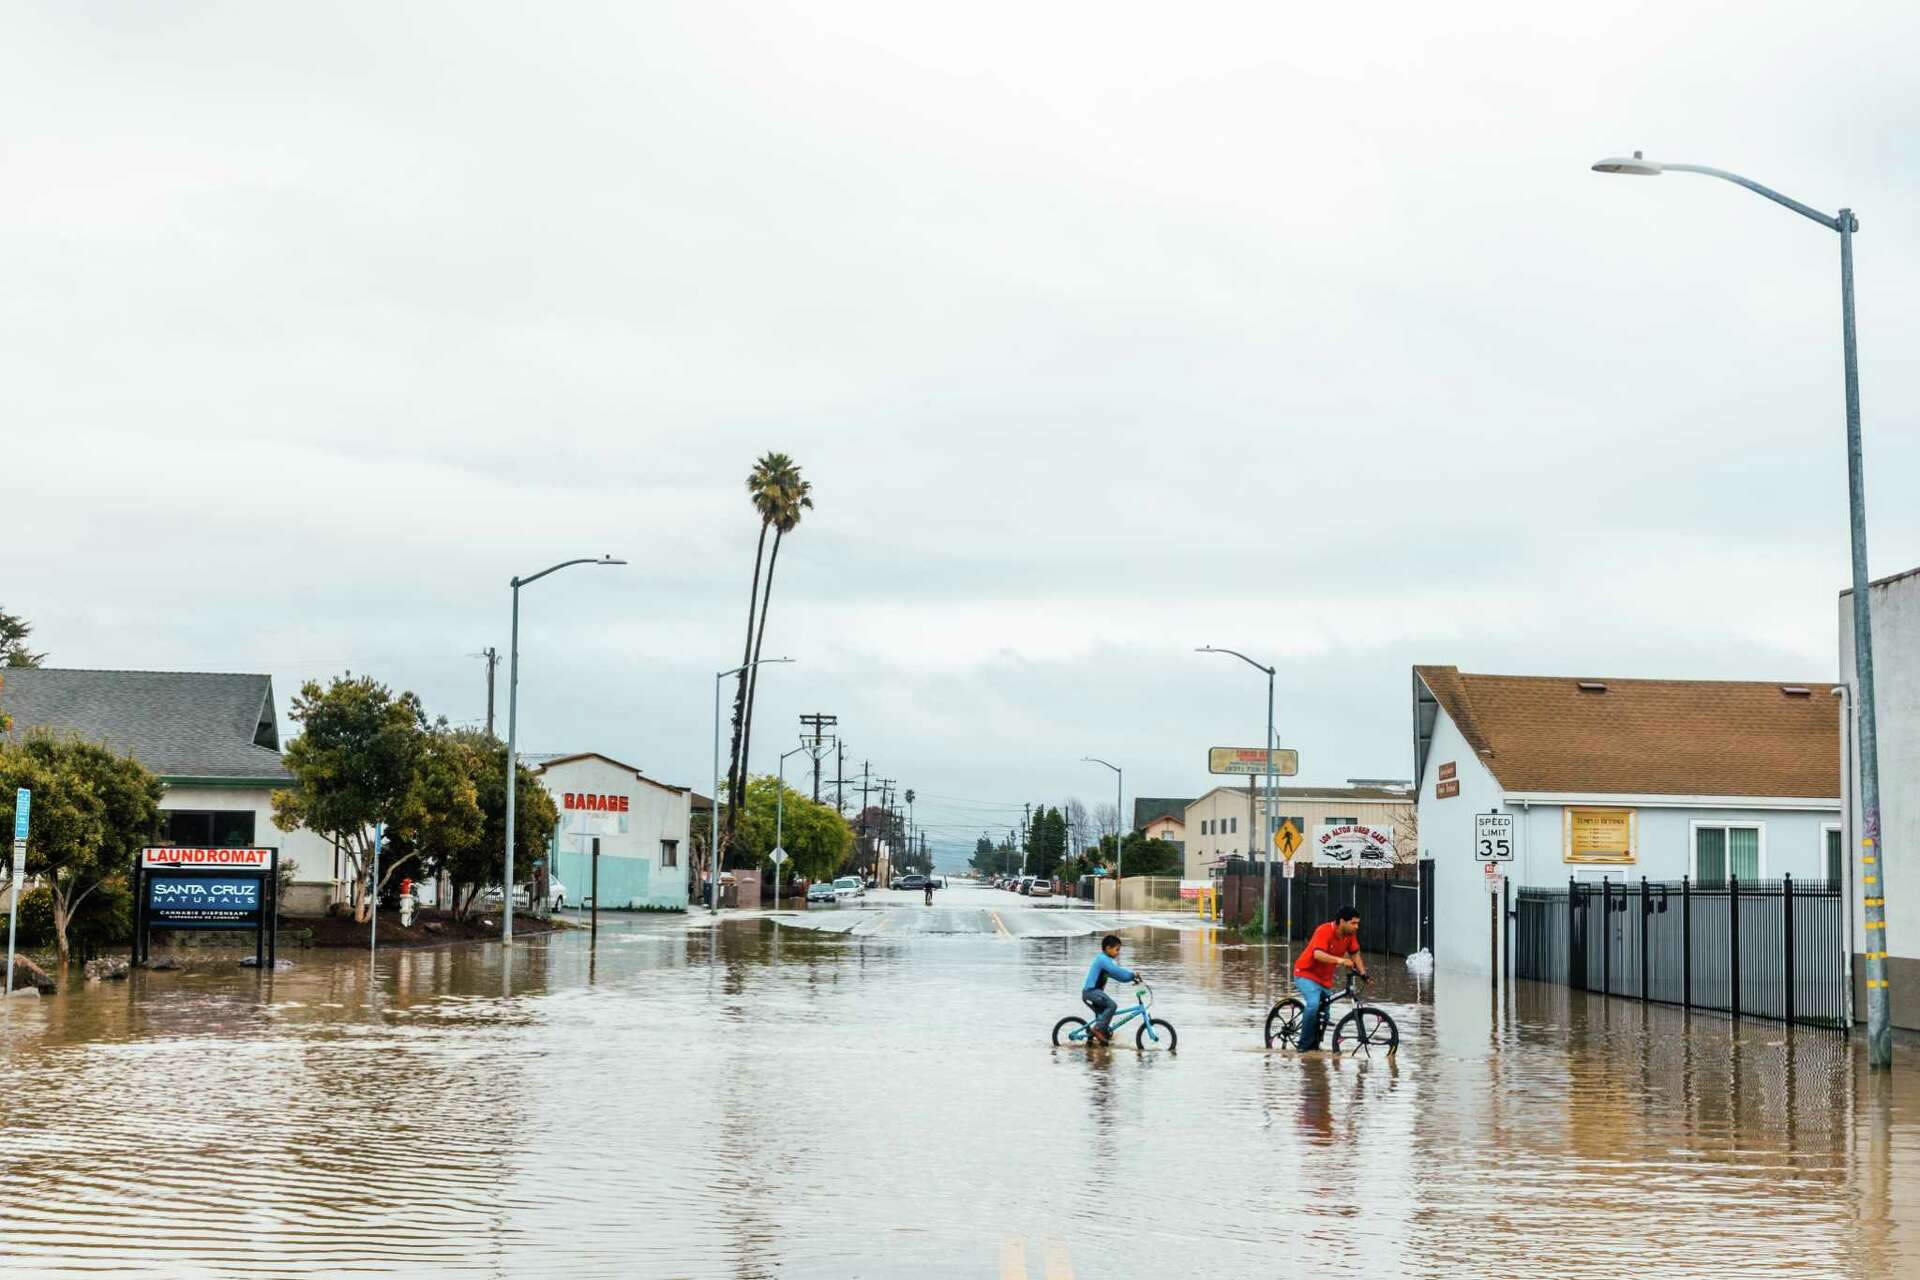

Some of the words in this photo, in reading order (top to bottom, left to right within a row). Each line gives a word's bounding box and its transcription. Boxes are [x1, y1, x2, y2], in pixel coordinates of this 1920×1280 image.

[564, 793, 629, 811] GARAGE
[1479, 818, 1510, 826] SPEED
[1320, 833, 1331, 844] LOS
[1332, 826, 1351, 836] ALTOS
[1354, 826, 1370, 835] USED
[1371, 831, 1387, 844] CARS
[1480, 840, 1509, 856] 35
[147, 849, 266, 862] LAUNDROMAT
[155, 884, 207, 895] SANTA
[211, 885, 255, 895] CRUZ
